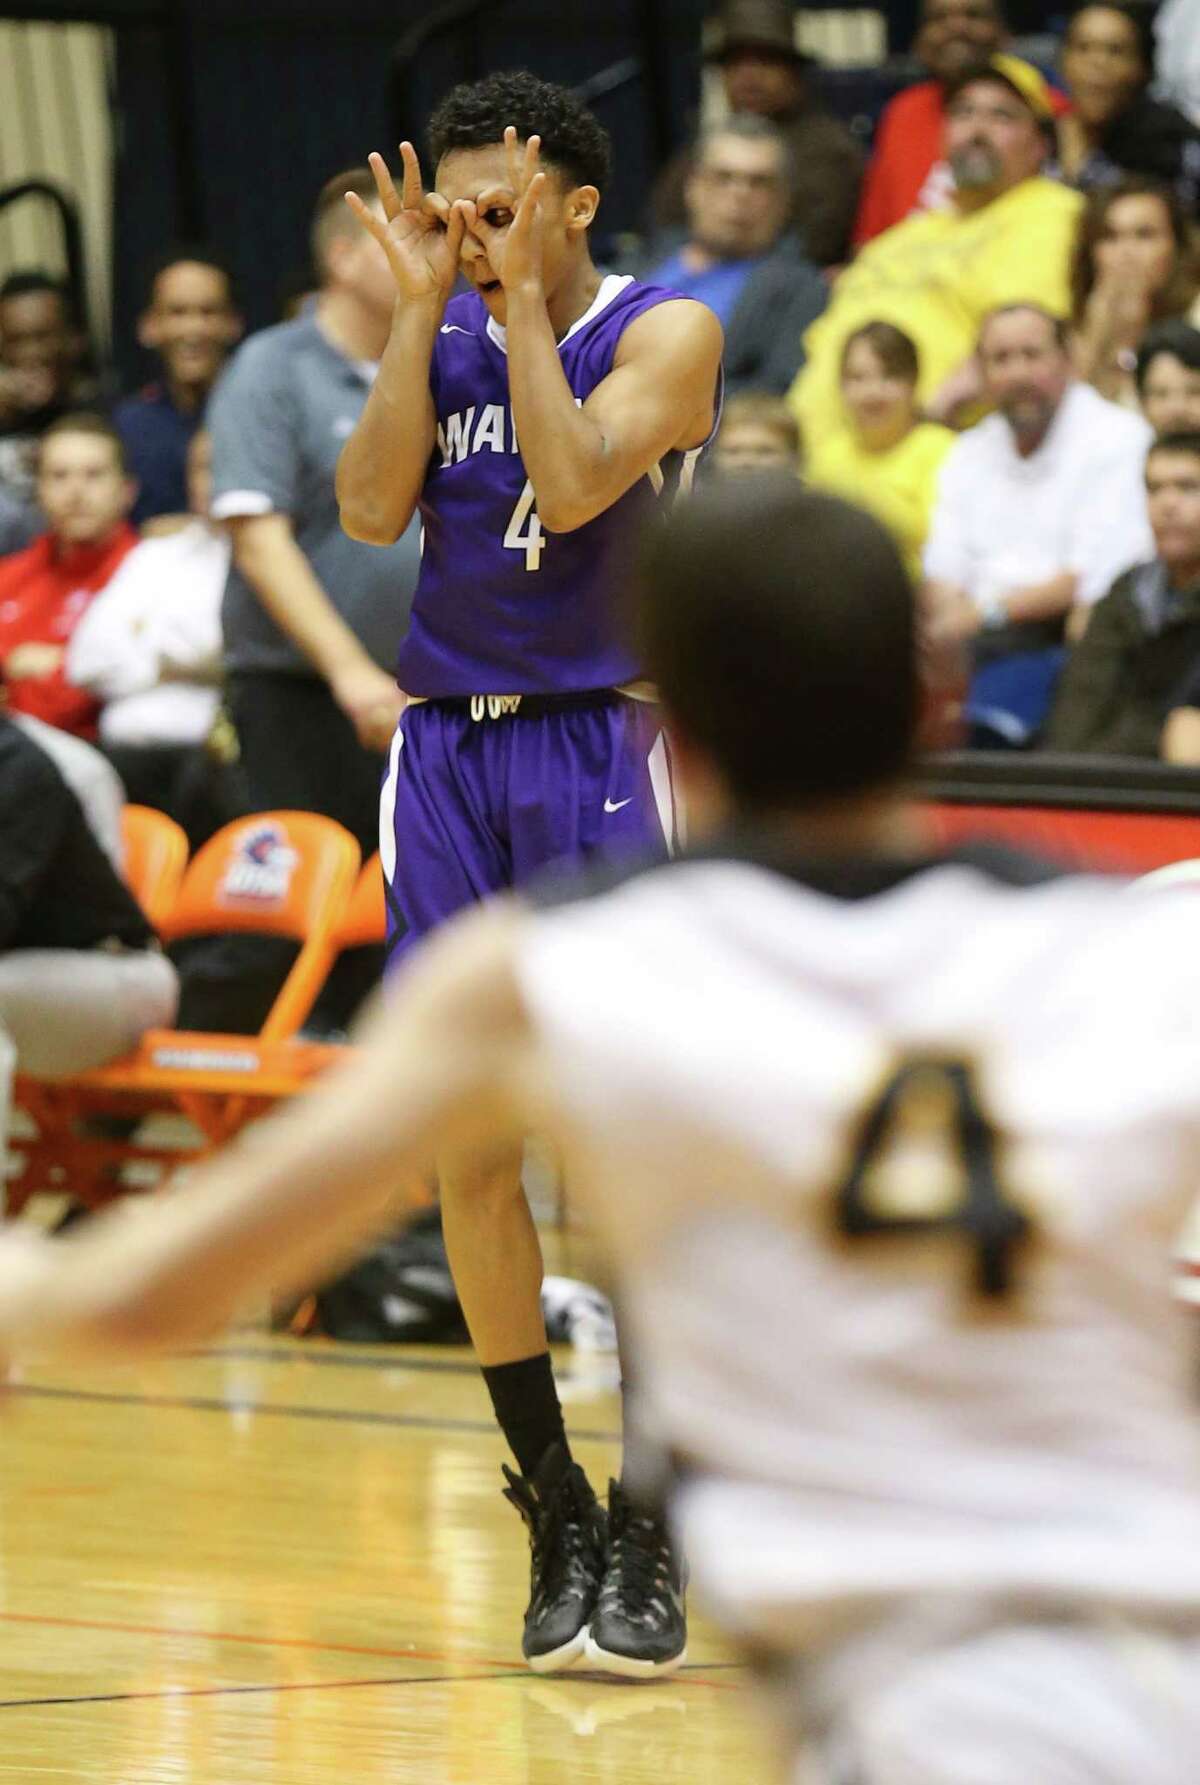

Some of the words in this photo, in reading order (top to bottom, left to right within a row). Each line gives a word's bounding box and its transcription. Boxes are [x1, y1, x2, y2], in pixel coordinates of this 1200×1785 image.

[437, 403, 518, 469] WA
[502, 478, 547, 572] 4
[832, 1048, 1038, 1310] 4
